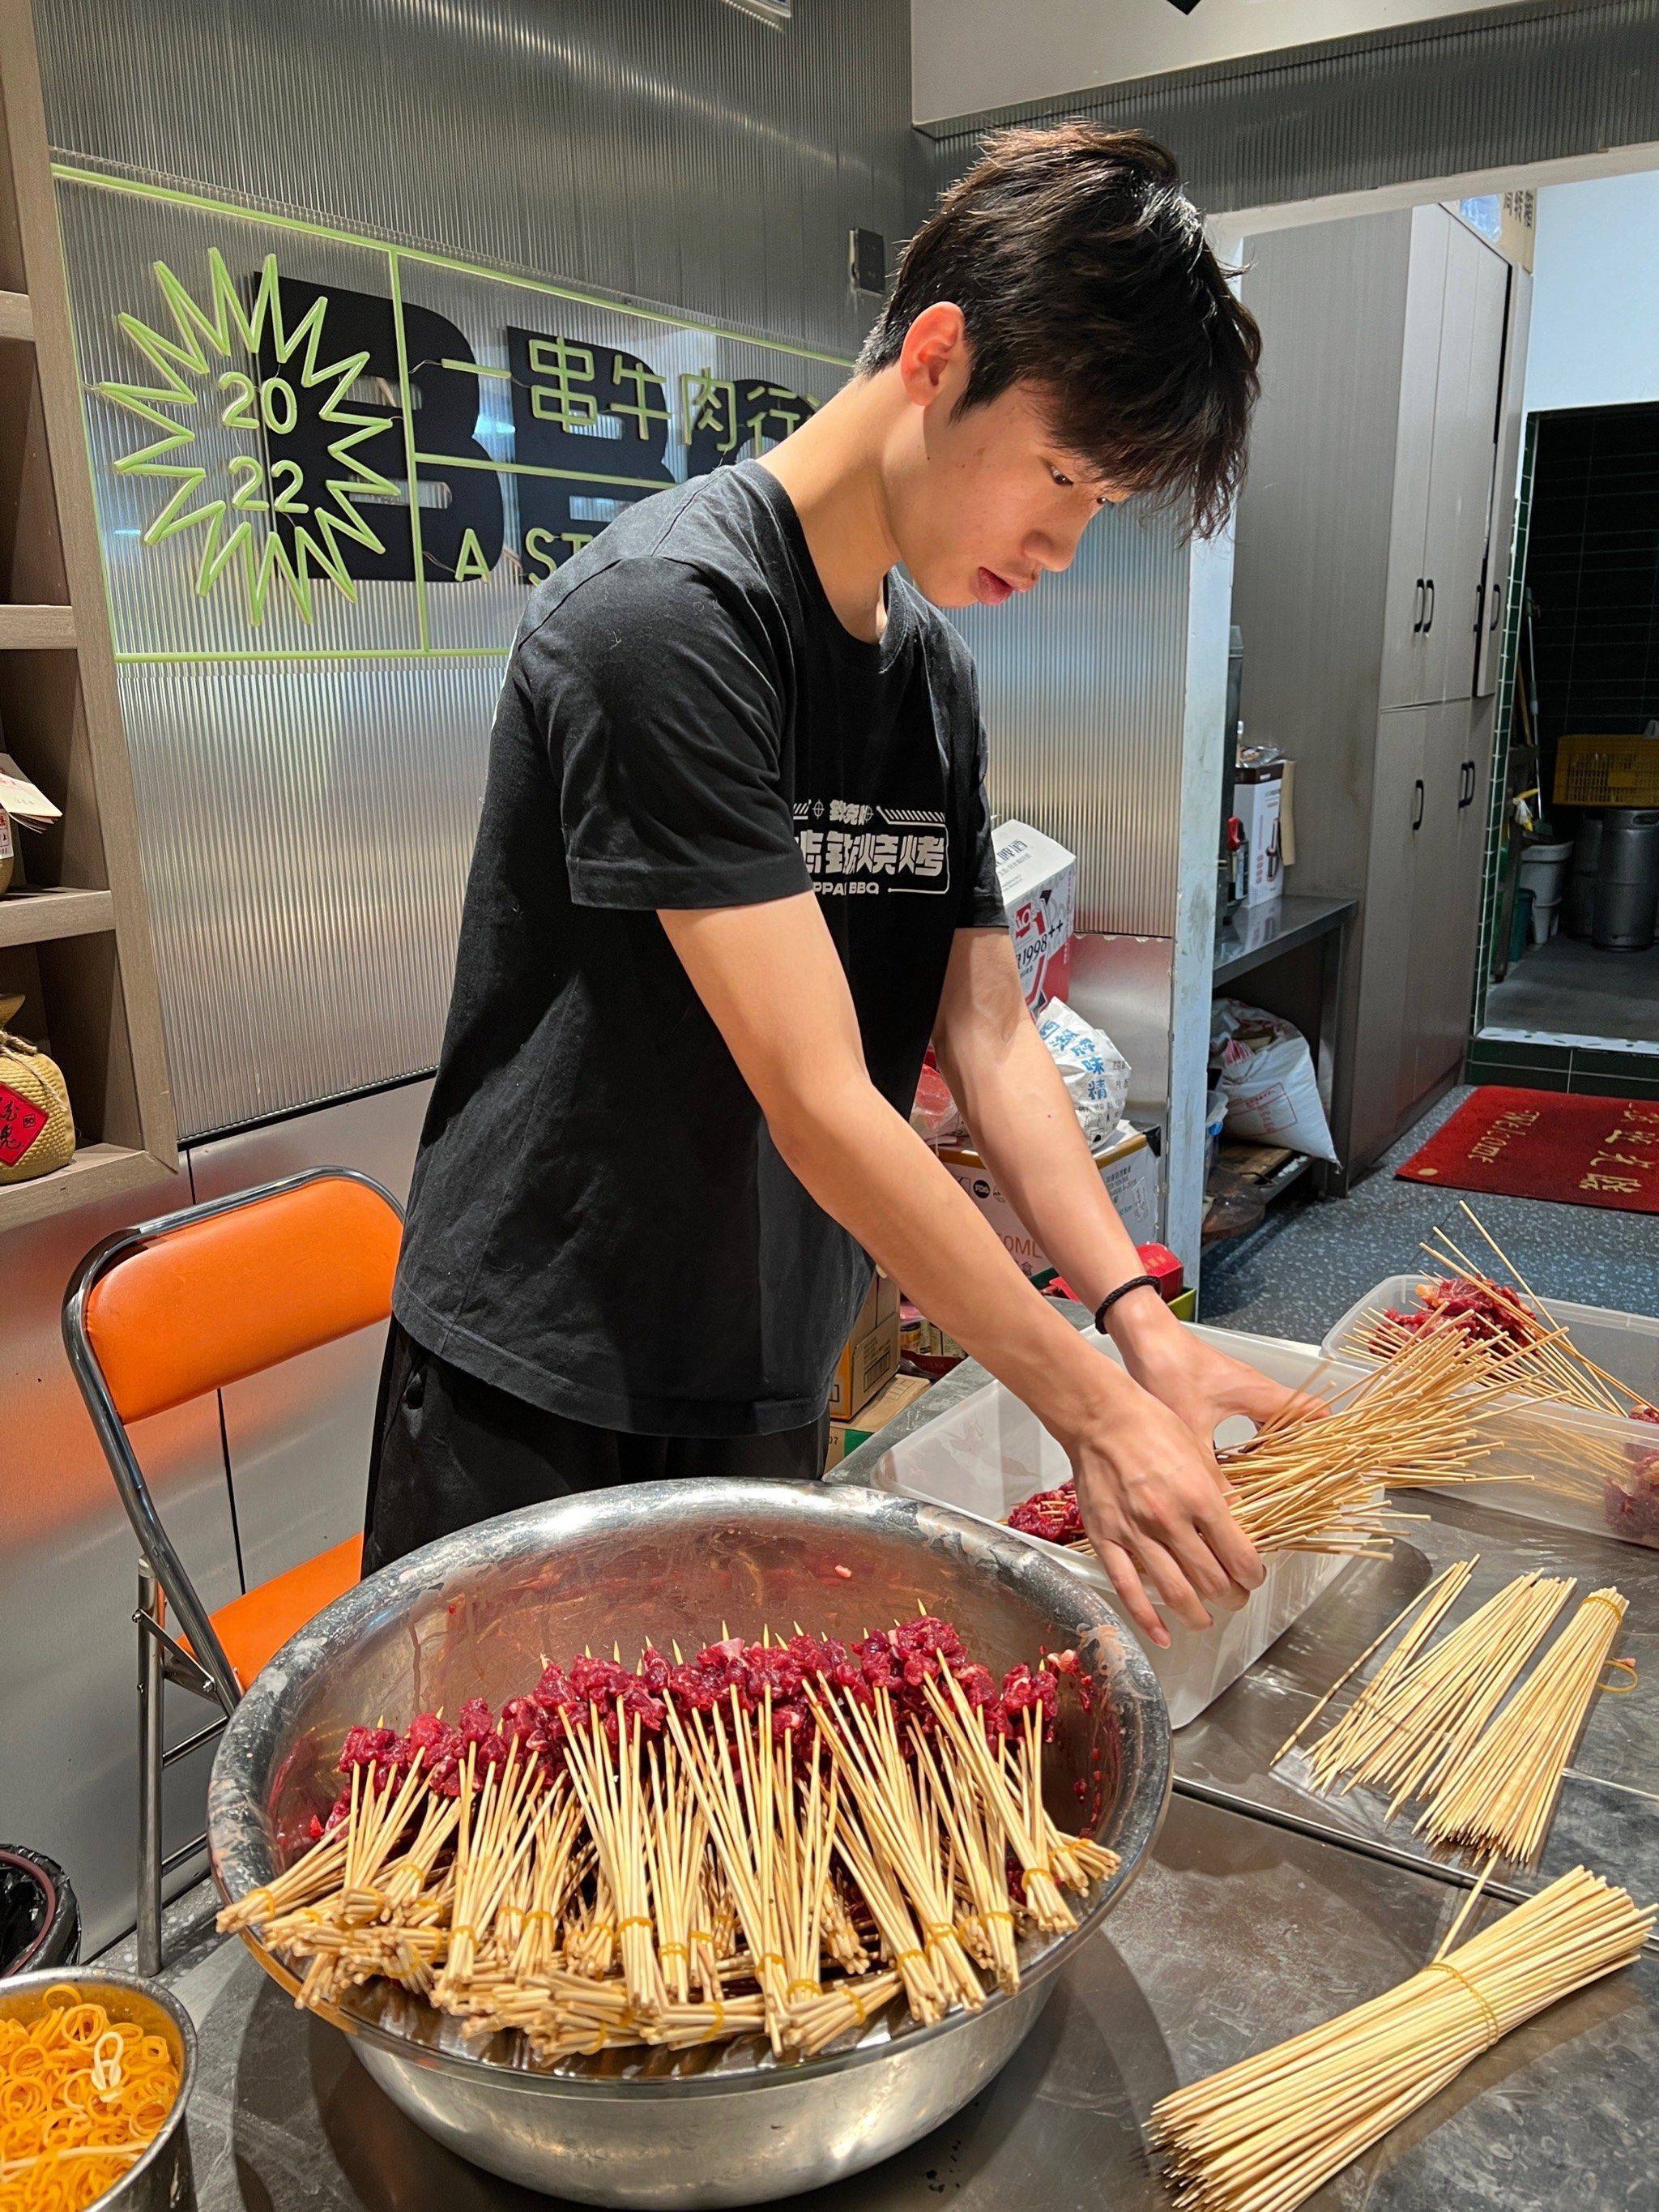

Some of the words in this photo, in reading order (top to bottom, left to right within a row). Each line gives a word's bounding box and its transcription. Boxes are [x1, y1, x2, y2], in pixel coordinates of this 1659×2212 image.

[218, 371, 298, 435] 20
[441, 335, 821, 459] 一串牛肉行
[228, 455, 309, 515] 22
[455, 528, 490, 583] A
[996, 839, 1029, 868] 啤酒
[848, 882, 881, 895] BBQ
[1017, 920, 1064, 970] 1998++
[998, 1233, 1042, 1259] 0ML
